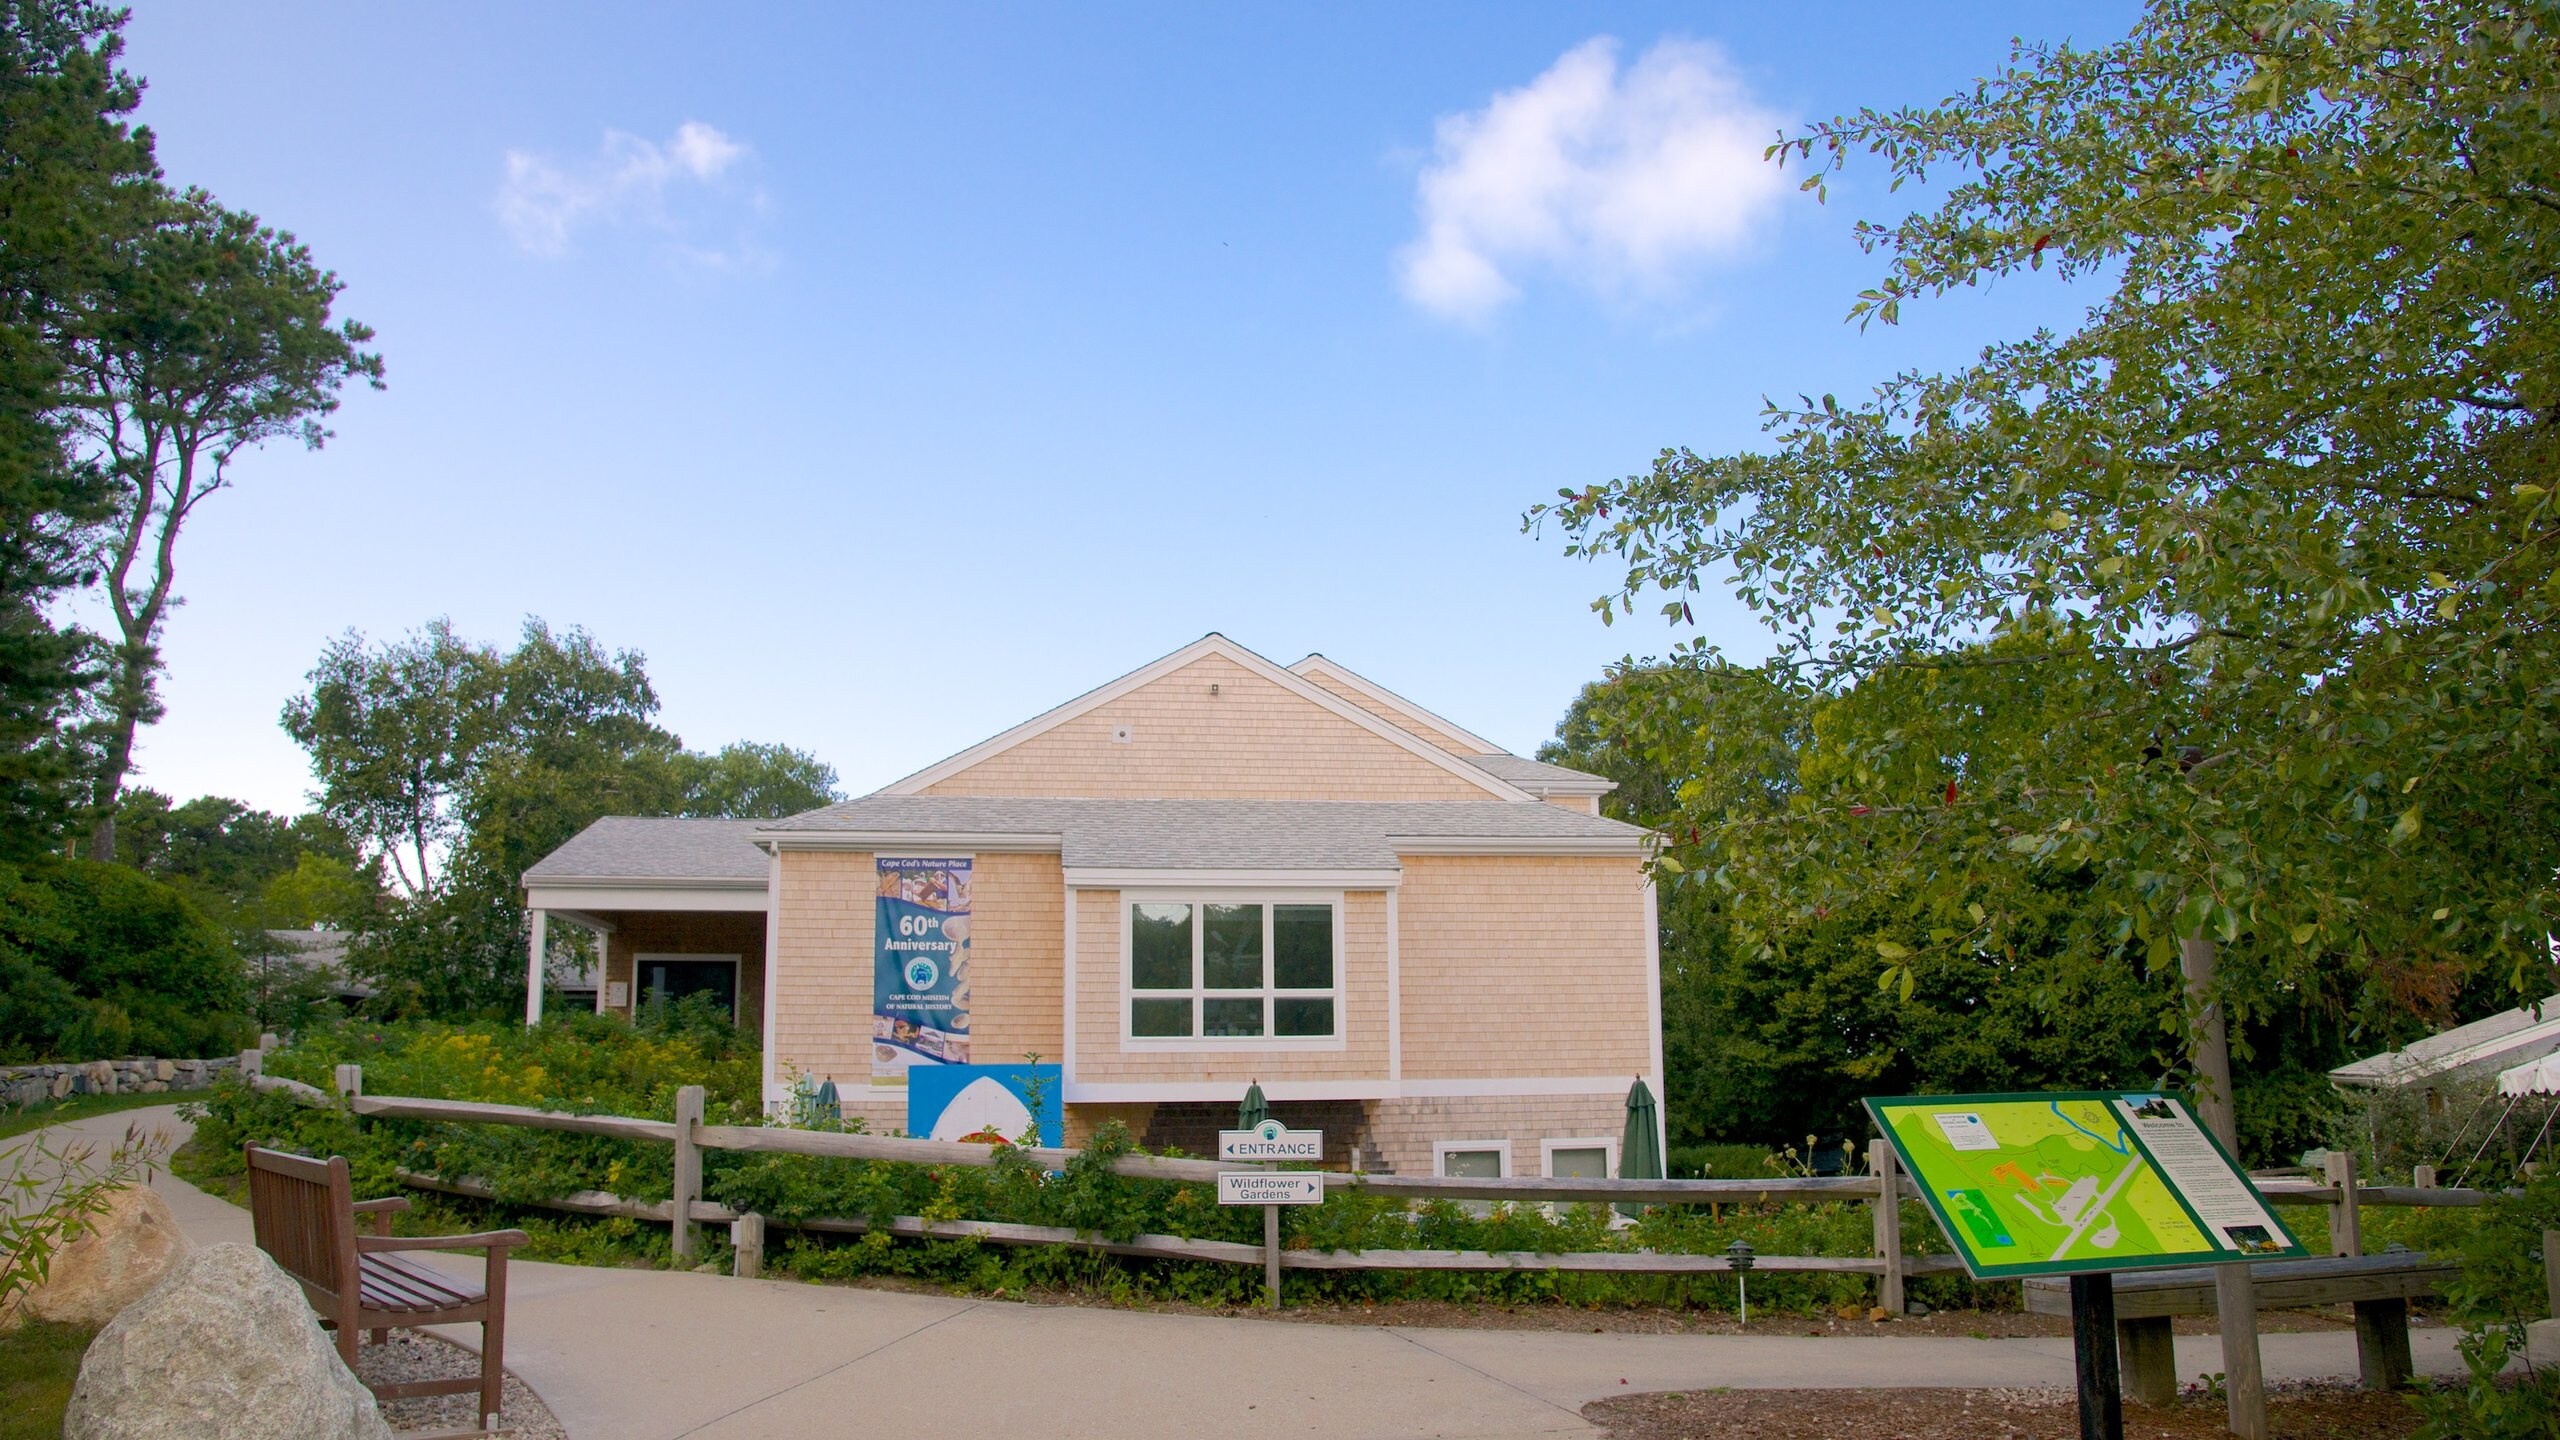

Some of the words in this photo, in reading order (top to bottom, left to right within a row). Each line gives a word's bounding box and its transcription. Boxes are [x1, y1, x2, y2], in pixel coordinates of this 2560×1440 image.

[881, 859, 900, 868] Cape
[901, 859, 920, 868] Cod's
[922, 859, 947, 868] Nature
[948, 859, 967, 868] Place
[900, 915, 939, 936] 60th
[884, 937, 957, 954] Anniversary
[1239, 1143, 1316, 1155] ENTRANCE
[1230, 1178, 1301, 1189] Wildflower
[1240, 1189, 1291, 1200] Gardens
